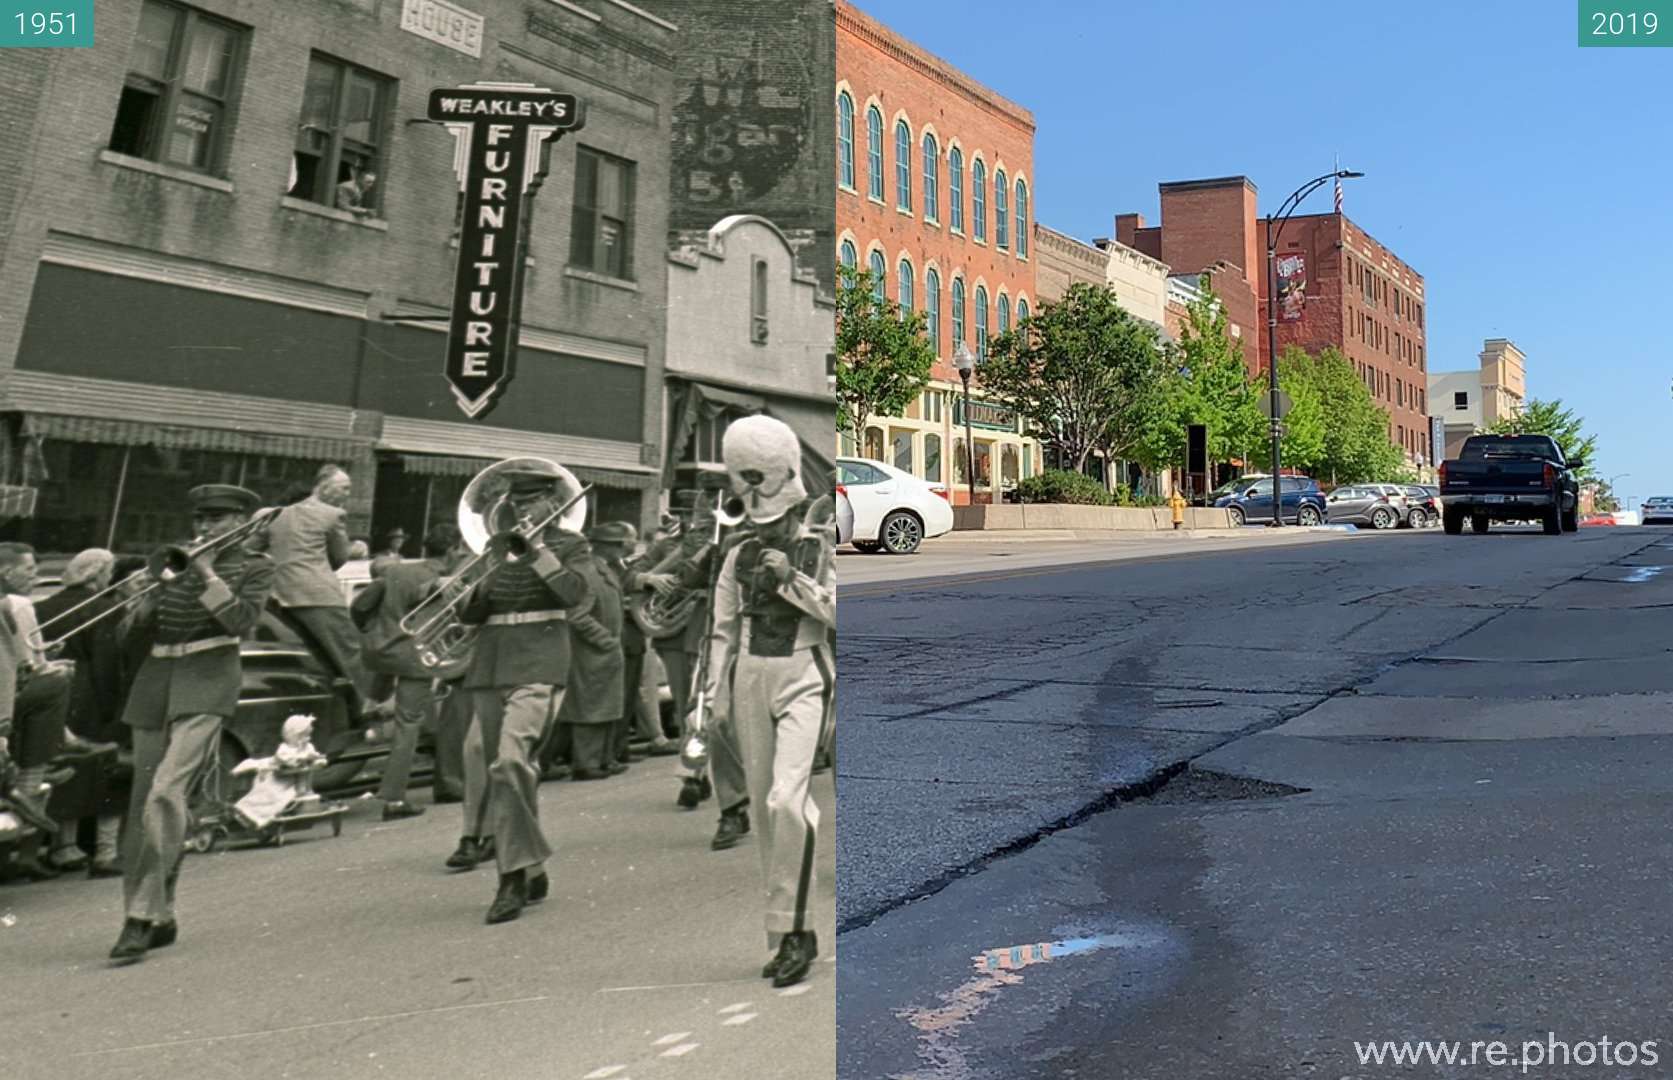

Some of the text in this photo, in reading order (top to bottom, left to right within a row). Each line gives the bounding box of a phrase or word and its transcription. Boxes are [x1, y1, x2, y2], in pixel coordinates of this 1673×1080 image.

[404, 0, 477, 49] HOUSE
[440, 97, 567, 118] WEAKLEY'S
[461, 124, 514, 377] FURNITURE
